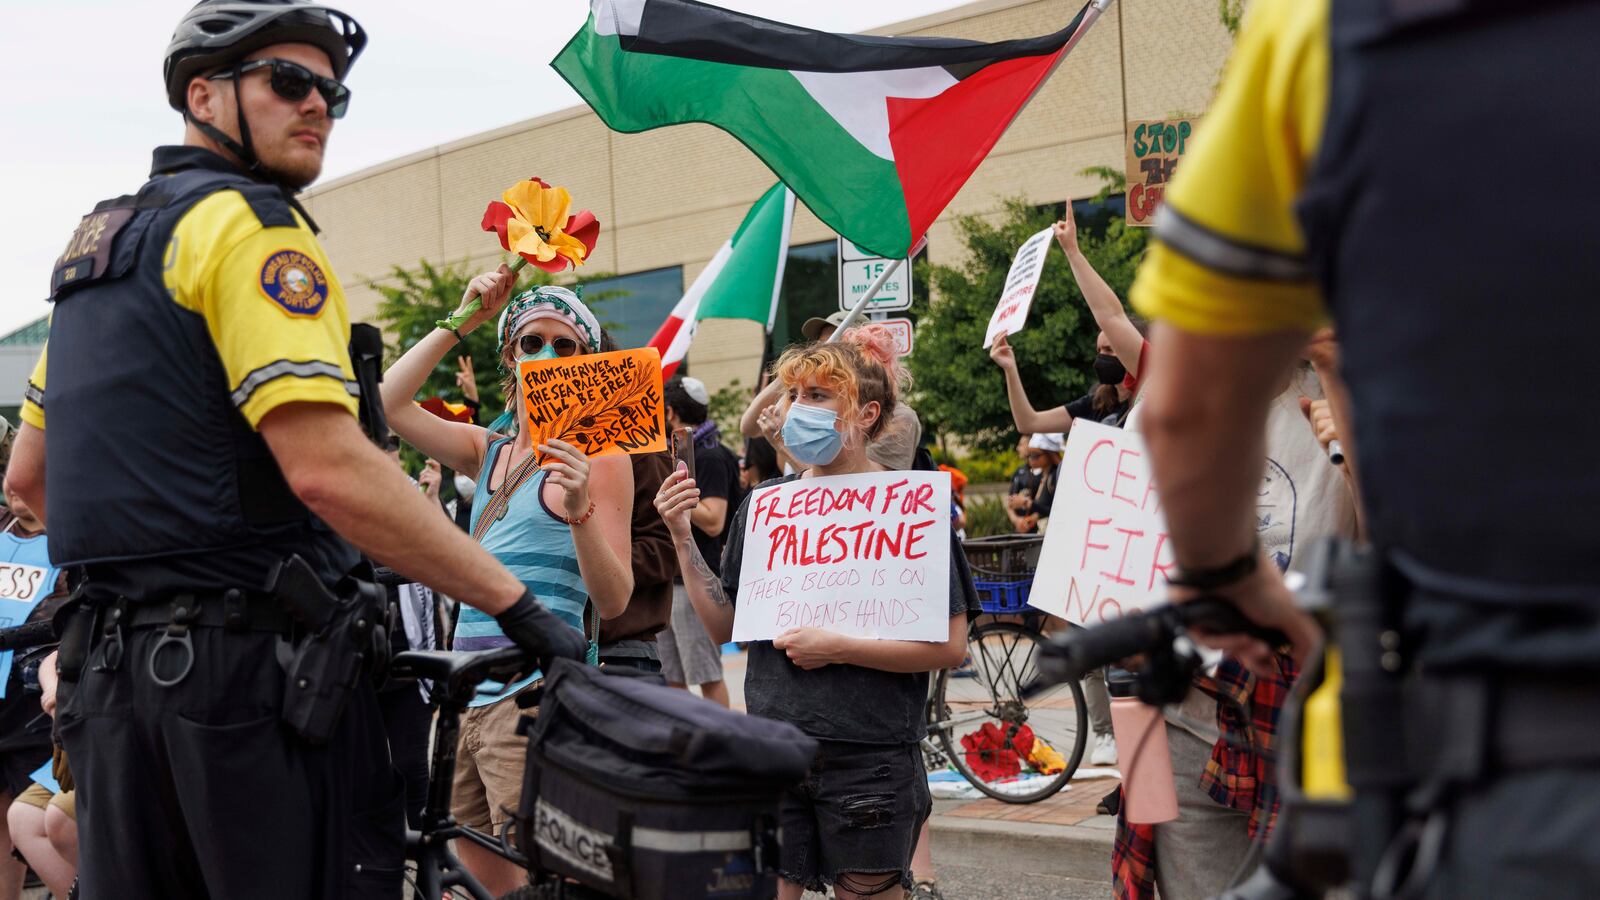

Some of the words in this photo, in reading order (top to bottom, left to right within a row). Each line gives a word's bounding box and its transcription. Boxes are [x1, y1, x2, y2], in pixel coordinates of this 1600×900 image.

[1134, 121, 1192, 158] STOP
[278, 291, 322, 309] PORTLAND
[852, 282, 900, 294] MINTES
[997, 302, 1021, 325] NOW
[525, 367, 557, 389] FROM
[555, 365, 578, 380] THE
[577, 360, 612, 379] RIVER
[527, 387, 550, 406] THE
[551, 383, 576, 401] SEA
[572, 357, 636, 391] PALESTINE
[529, 399, 569, 428] WILL
[576, 389, 596, 406] BE
[600, 371, 633, 401] FREE
[585, 385, 660, 456] CEASEFIRE
[614, 415, 661, 452] NOW
[752, 486, 877, 533] FREEDOM
[881, 478, 936, 516] FOR
[767, 519, 936, 572] PALESTINE
[1081, 518, 1176, 592] FIR
[744, 576, 792, 606] THEIR
[801, 568, 861, 592] BLOOD
[872, 568, 887, 586] IS
[899, 567, 926, 586] ON
[1065, 576, 1126, 624] NO
[776, 600, 852, 629] BIDENS
[855, 598, 923, 629] HANDS
[538, 809, 609, 869] POLICE
